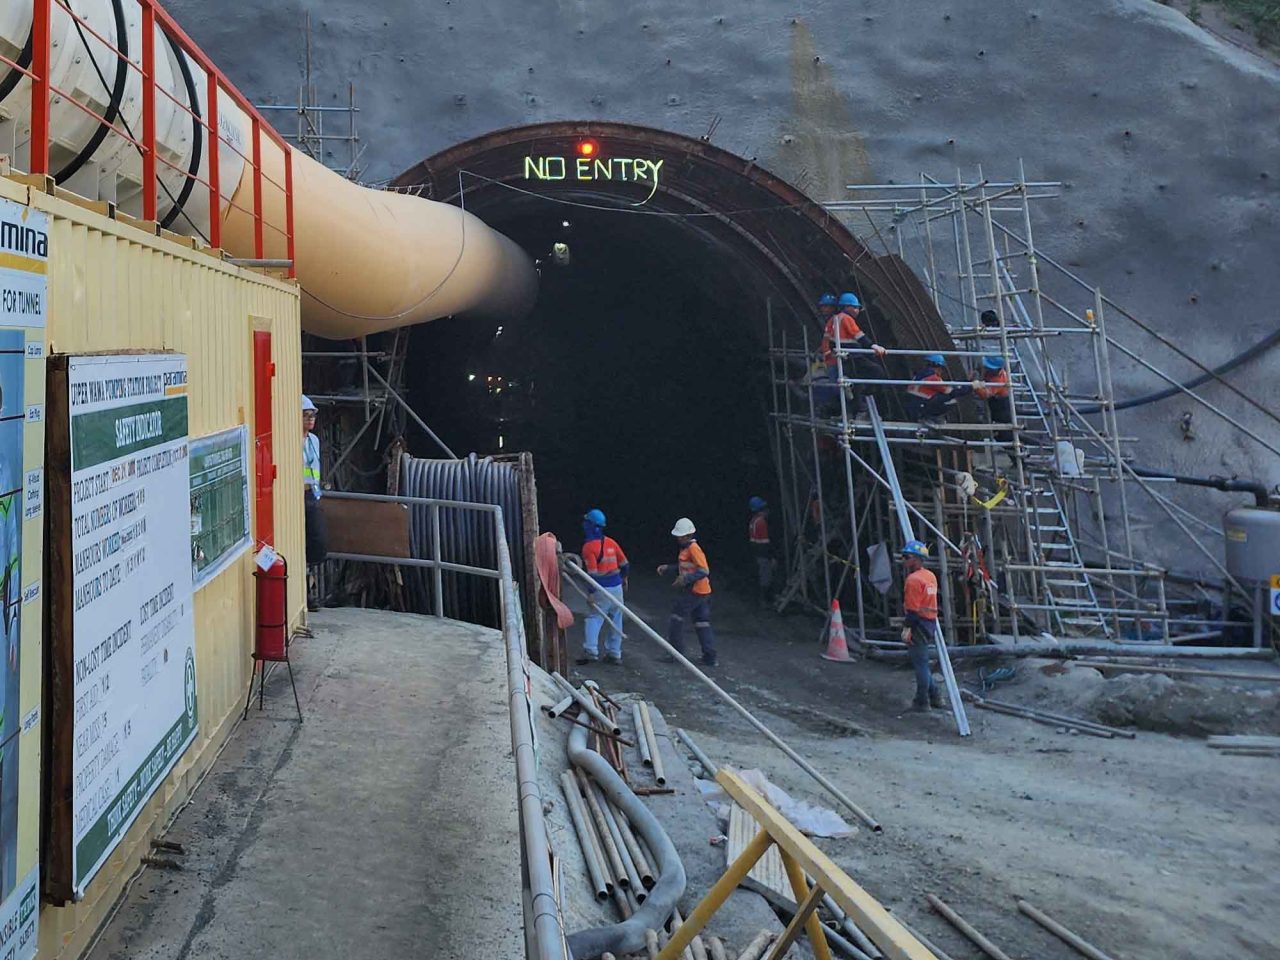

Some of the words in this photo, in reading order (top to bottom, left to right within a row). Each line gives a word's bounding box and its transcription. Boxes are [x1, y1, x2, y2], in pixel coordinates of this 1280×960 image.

[524, 156, 566, 181] NO
[576, 158, 664, 207] ENTRY
[3, 289, 17, 313] FOR
[18, 291, 41, 315] TUNNEL
[116, 417, 135, 446] SAFETY
[136, 412, 162, 440] INDICATOR
[75, 513, 89, 539] TOTAL
